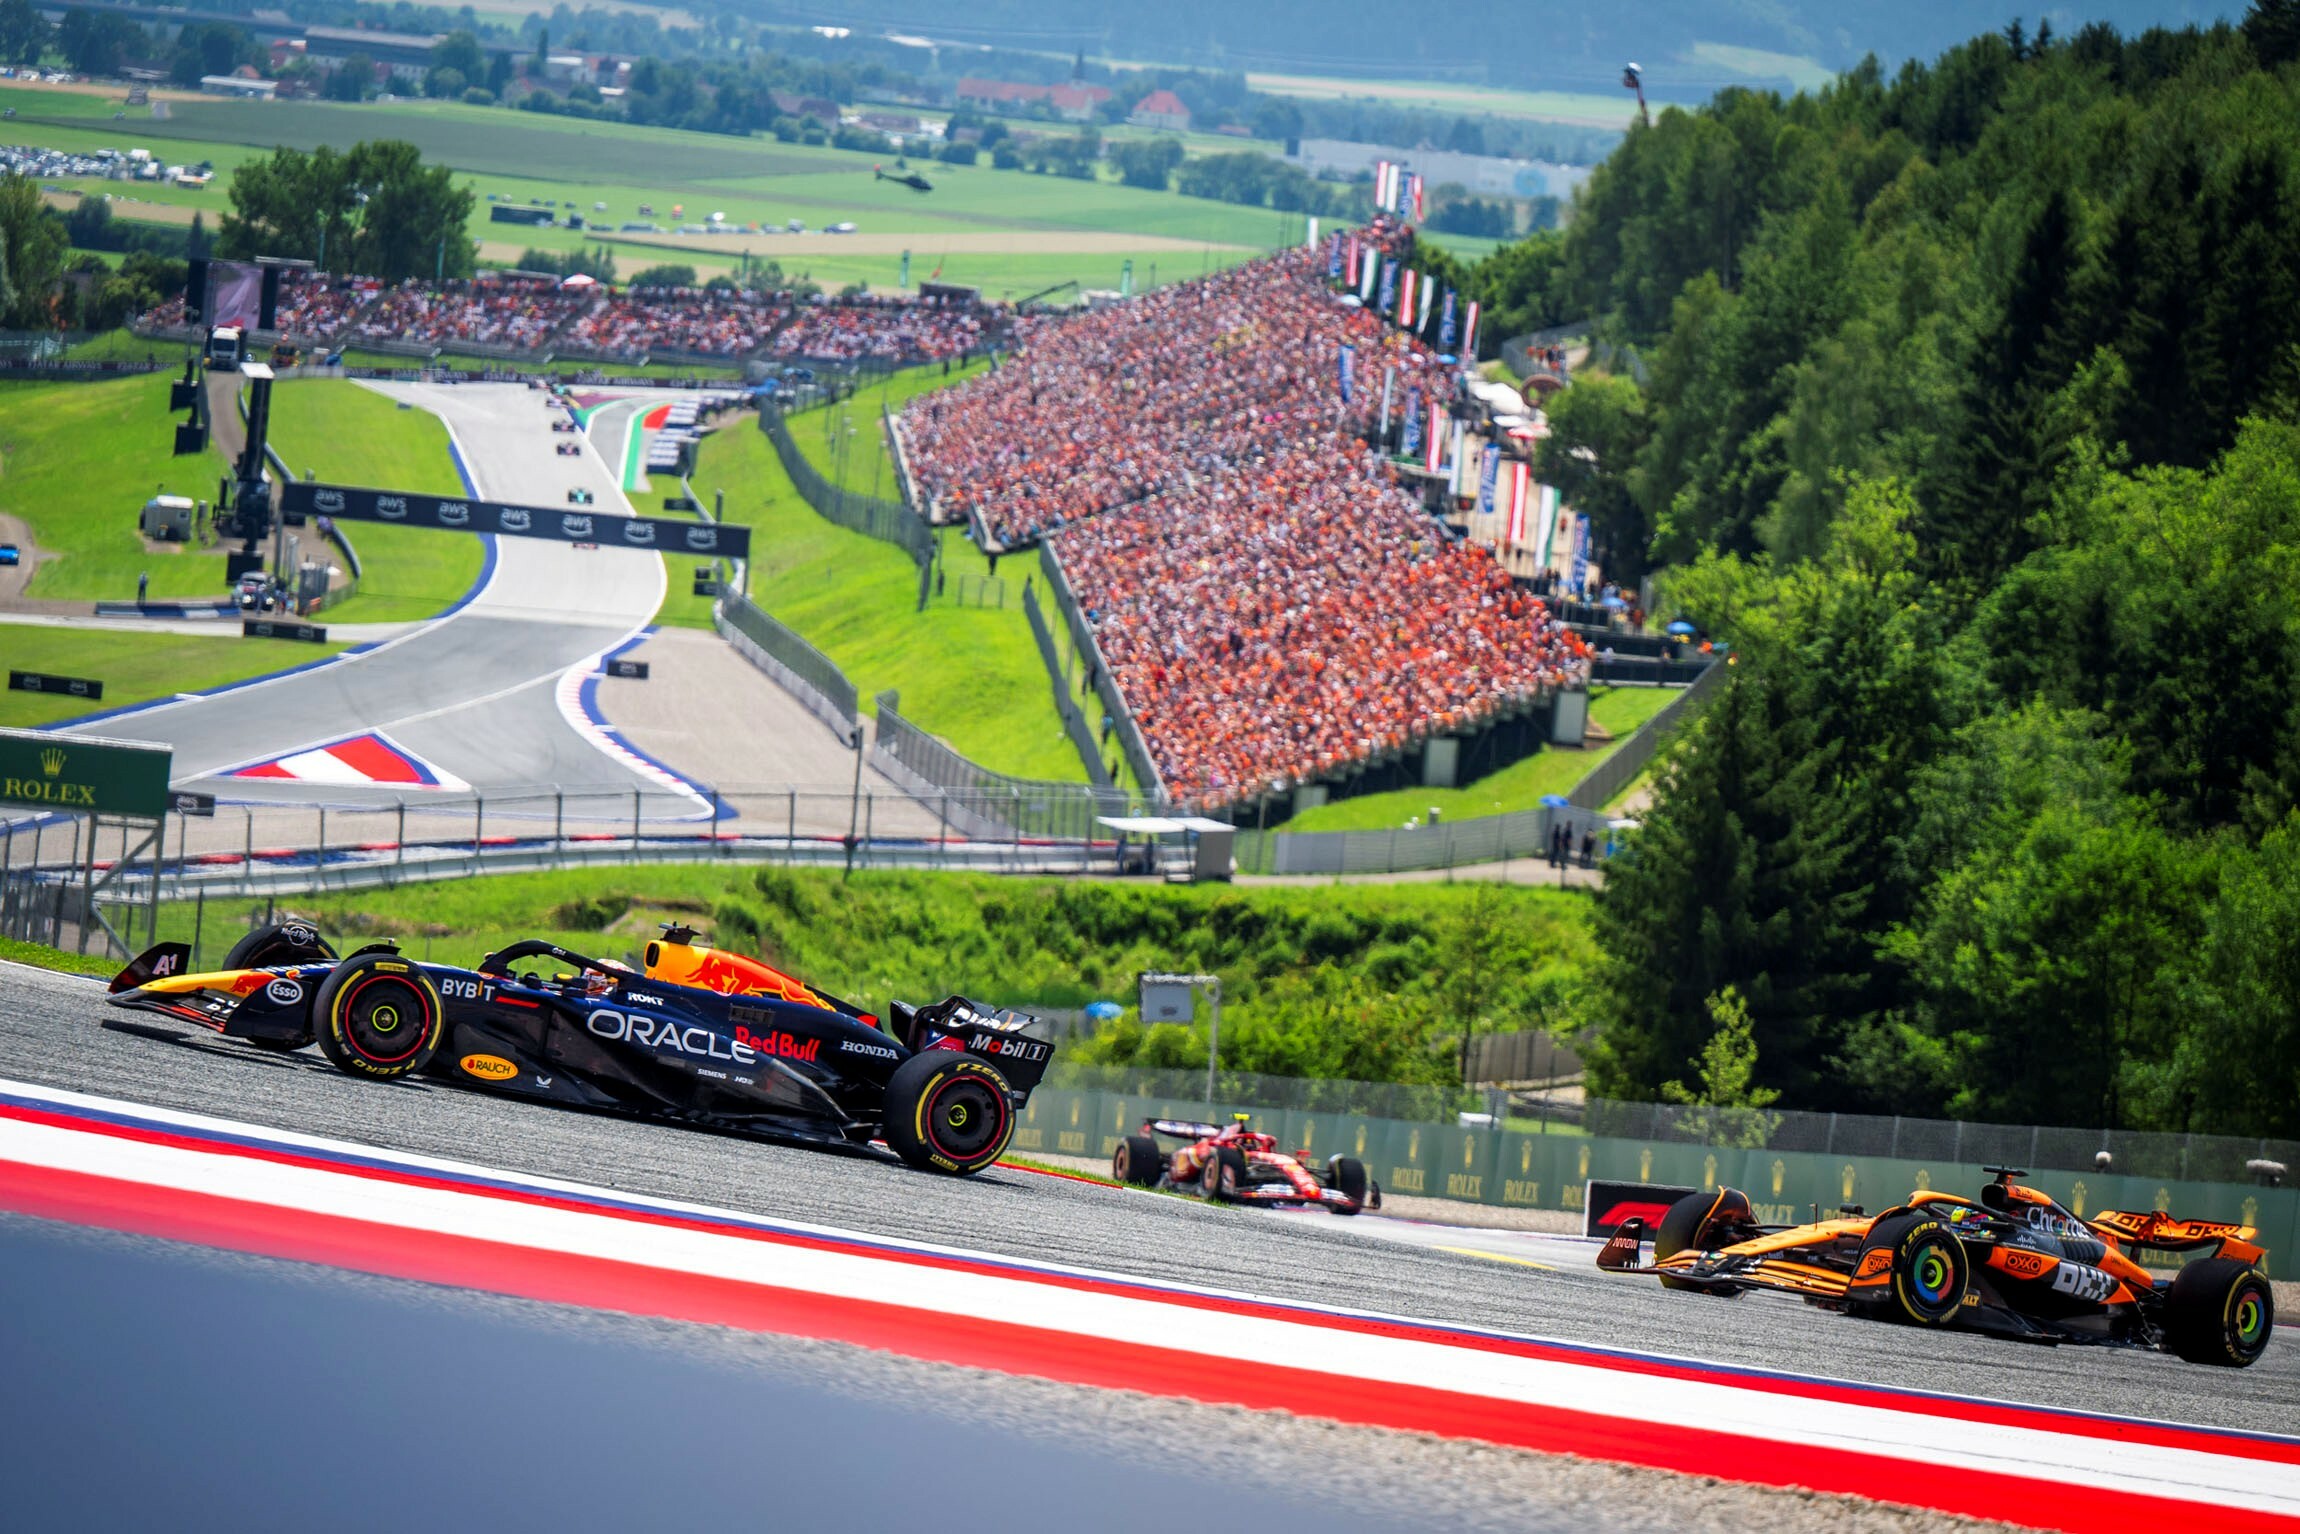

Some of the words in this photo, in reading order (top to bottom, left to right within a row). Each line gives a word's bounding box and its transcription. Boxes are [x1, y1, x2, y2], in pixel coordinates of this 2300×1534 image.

[314, 489, 345, 502] aws
[376, 495, 407, 508] aws
[439, 502, 469, 515] aws
[502, 508, 531, 521] aws
[562, 514, 593, 528] aws
[625, 520, 656, 534] aws
[688, 526, 718, 540] aws
[4, 777, 97, 806] ROLEX
[152, 953, 179, 976] A1
[441, 978, 496, 1002] BYBIT
[586, 1008, 758, 1065] ORACLE
[970, 1033, 1028, 1058] Mobil
[840, 1040, 900, 1061] HONDA
[351, 1058, 402, 1076] ZERO
[474, 1059, 512, 1075] RAUCH
[969, 1063, 1009, 1093] ZERO
[1504, 1179, 1539, 1204] ROLEX
[1562, 1184, 1585, 1207] ROL
[2027, 1206, 2090, 1239] Chrome
[1907, 1221, 1938, 1245] ZERO
[2006, 1254, 2042, 1273] OXXO
[1961, 1294, 1980, 1307] ALT
